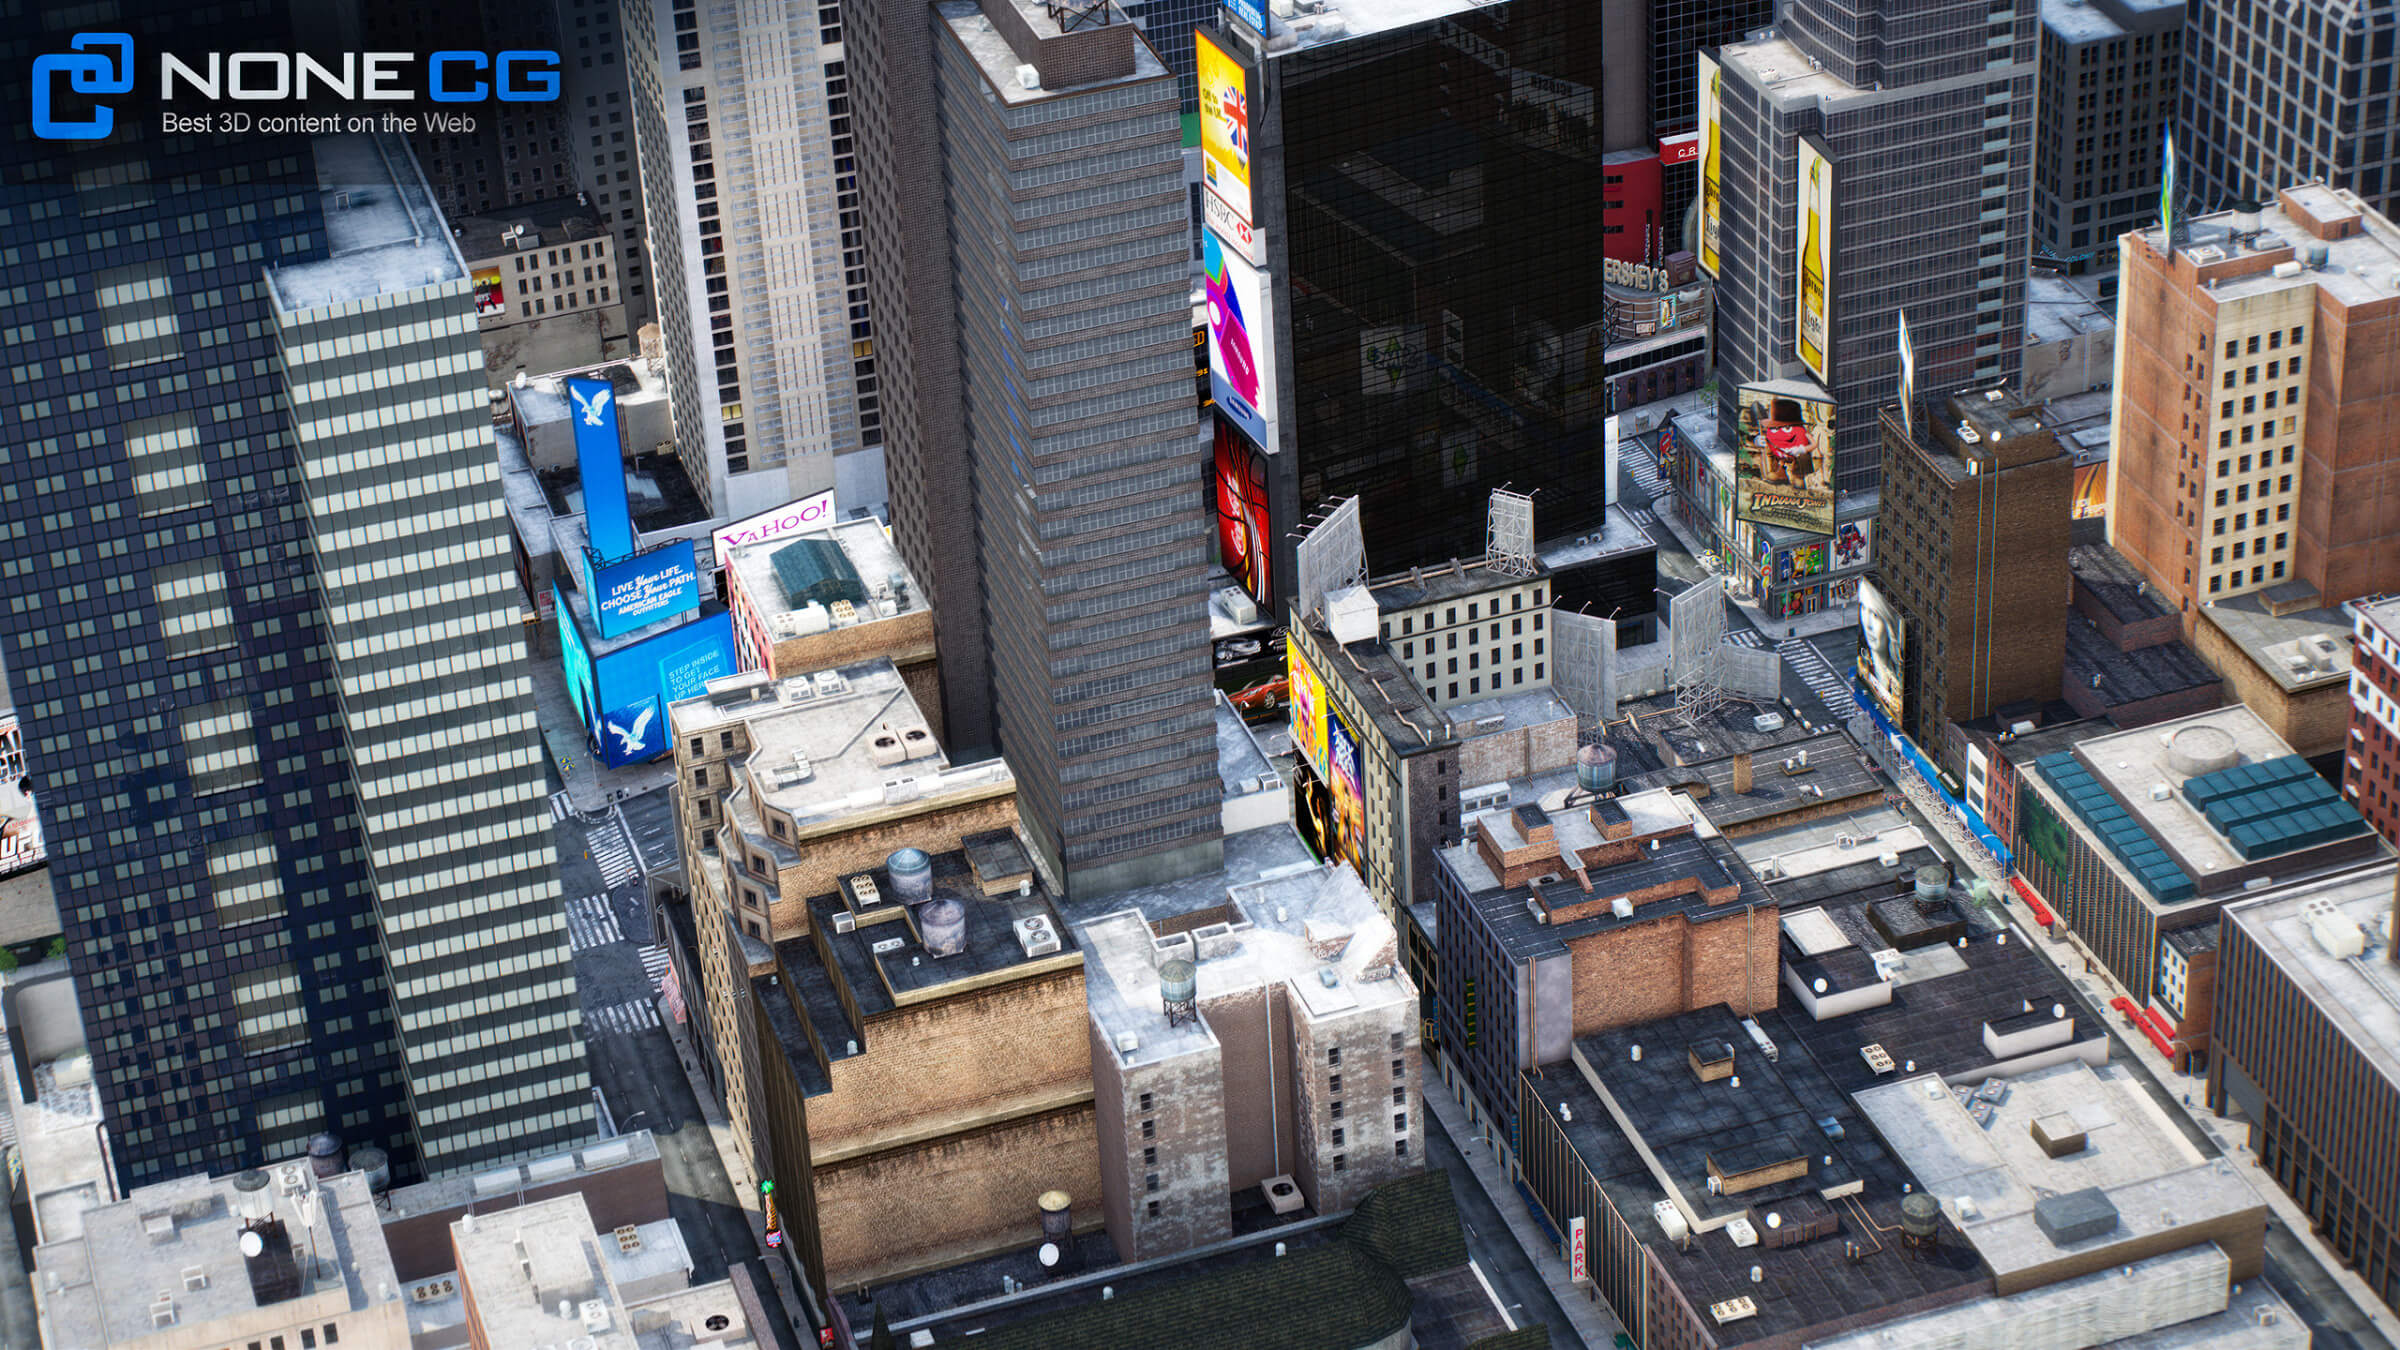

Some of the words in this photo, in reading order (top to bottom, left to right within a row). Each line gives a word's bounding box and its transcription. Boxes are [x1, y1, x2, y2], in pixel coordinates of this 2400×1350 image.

[1603, 258, 1669, 293] ERSHEY'S
[719, 499, 828, 546] YAHOO!
[600, 589, 643, 611] CHOOSE
[668, 571, 697, 589] PATH.
[611, 580, 634, 597] LIVE
[617, 596, 658, 616] AMERICAN
[1575, 1228, 1584, 1277] PARK
